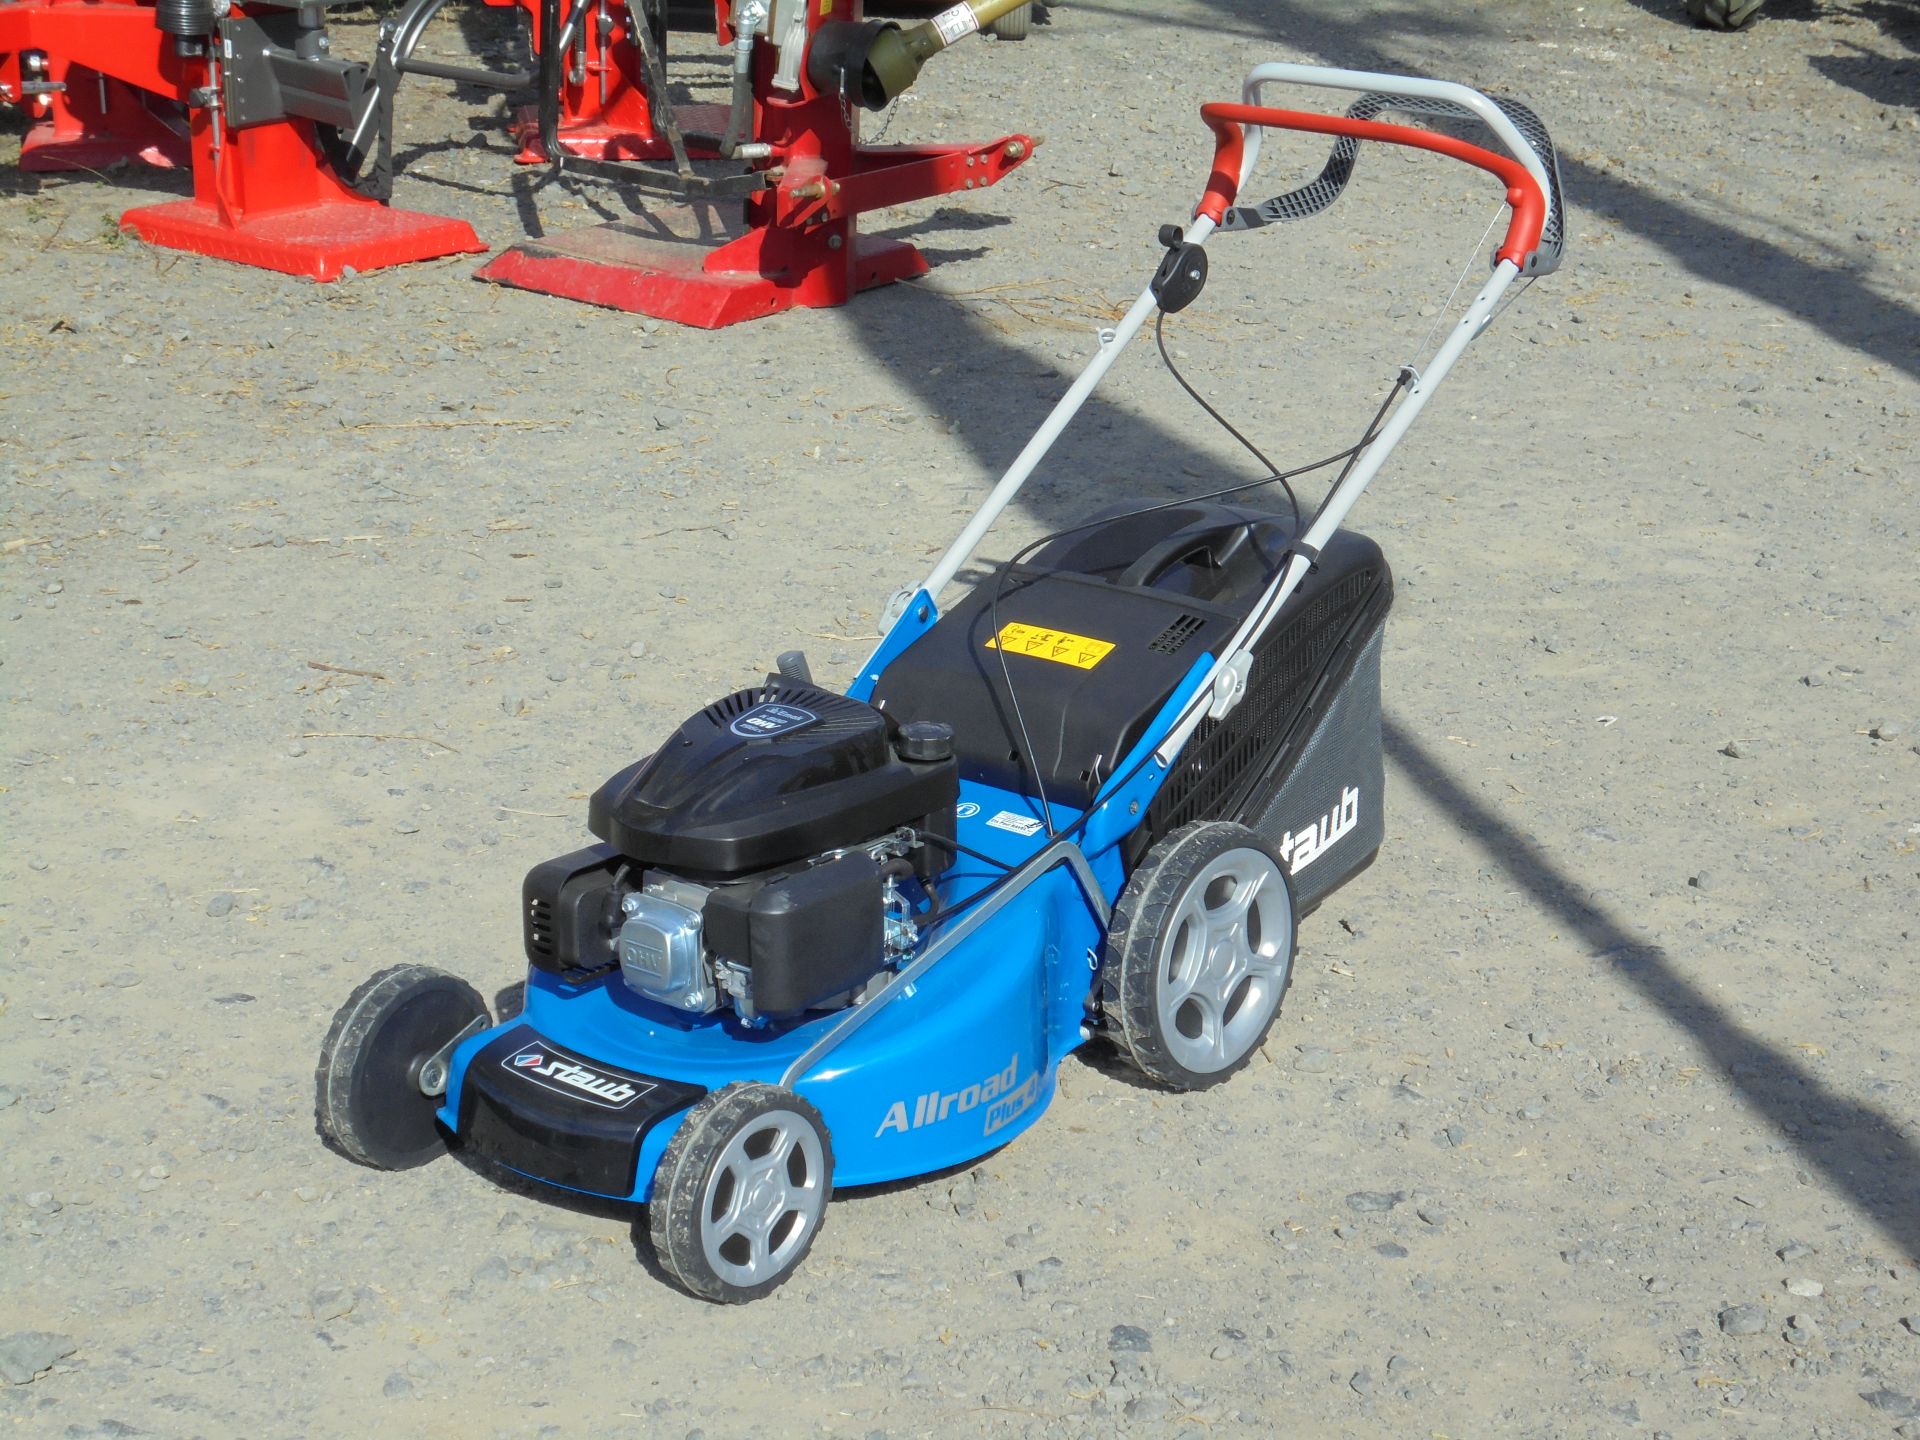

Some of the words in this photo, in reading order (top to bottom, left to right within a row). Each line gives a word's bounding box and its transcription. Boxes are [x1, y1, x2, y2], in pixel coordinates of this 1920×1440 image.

[745, 717, 781, 729] OHV
[1280, 786, 1359, 876] taub
[624, 946, 663, 971] OHV
[874, 1053, 1018, 1138] Allroad
[989, 1094, 1025, 1129] Plus
